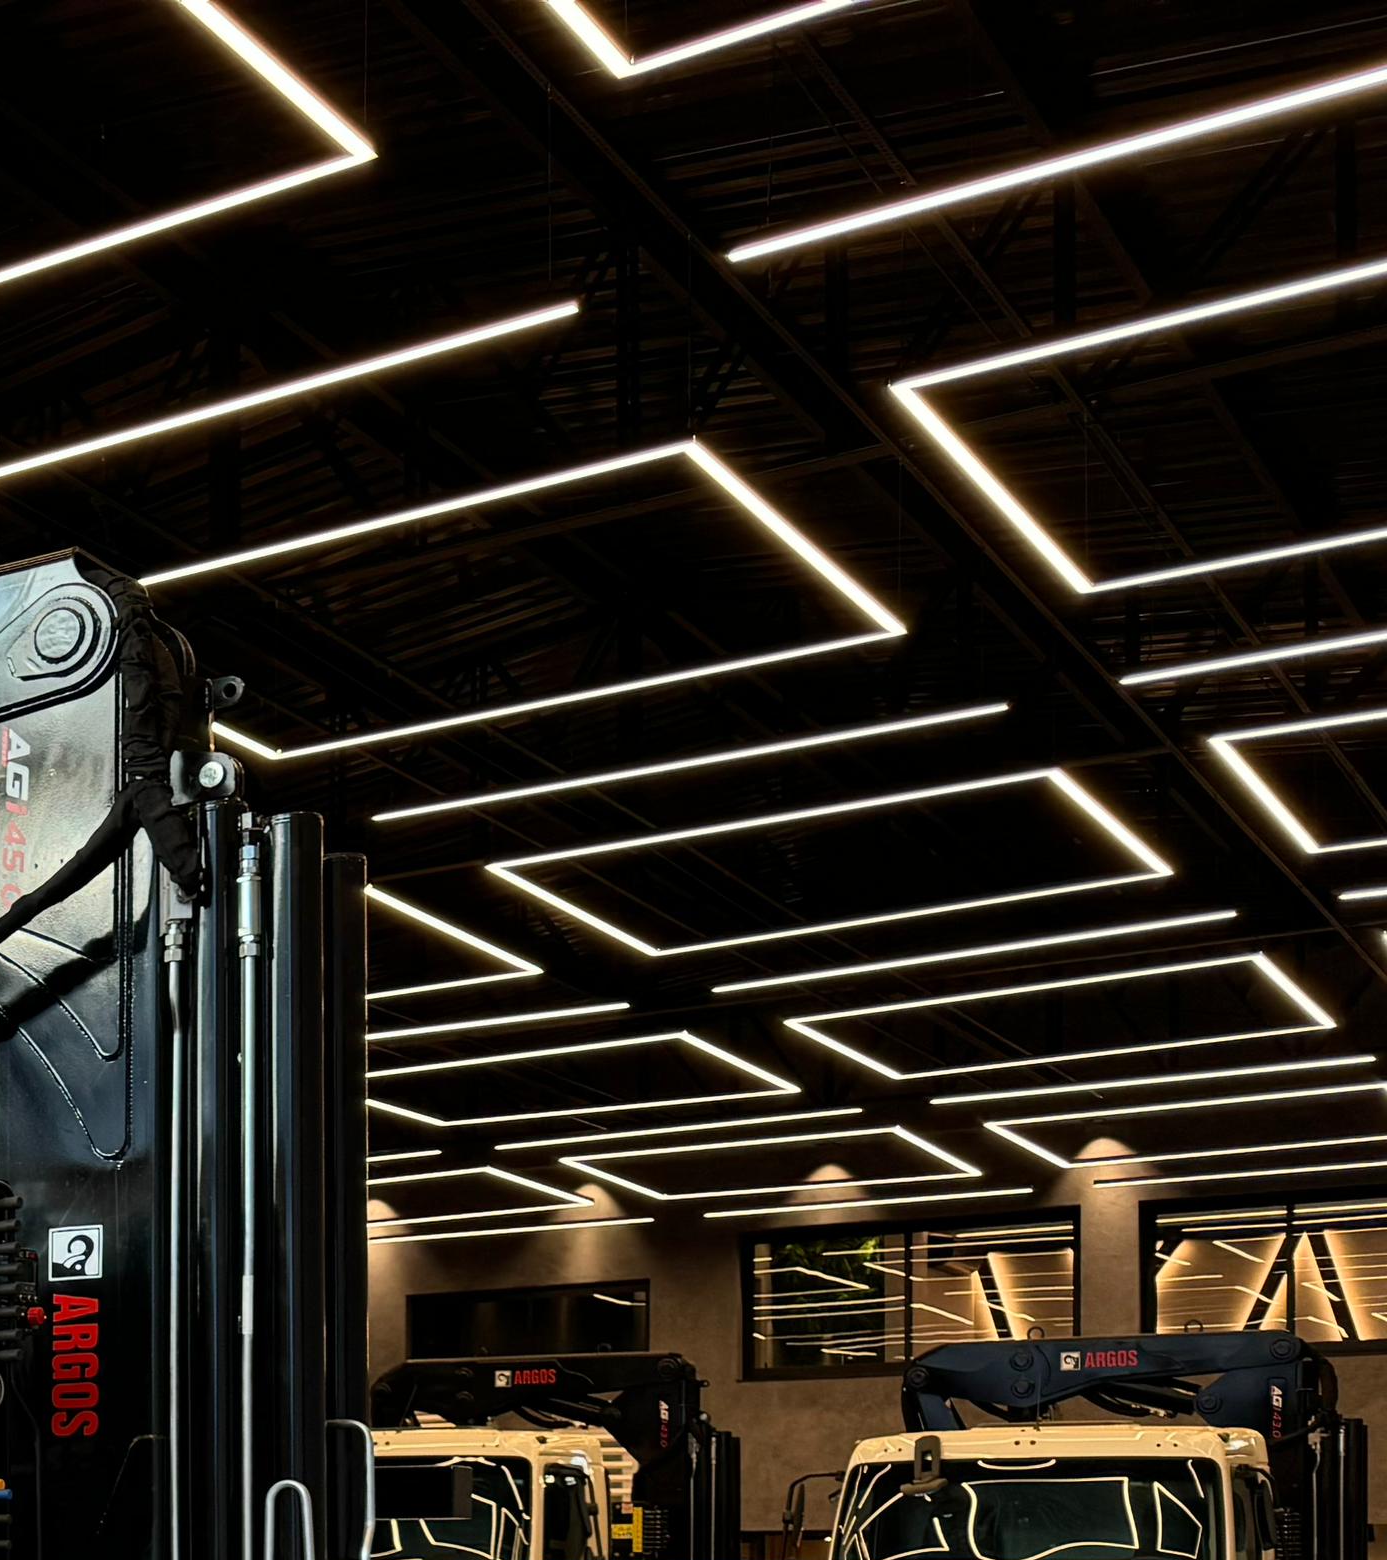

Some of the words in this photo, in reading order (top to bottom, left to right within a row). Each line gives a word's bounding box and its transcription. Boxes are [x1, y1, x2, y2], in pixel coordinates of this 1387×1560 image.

[51, 1293, 100, 1438] ARGOS
[1084, 1349, 1139, 1369] ARGOS
[513, 1367, 558, 1386] ARGOS
